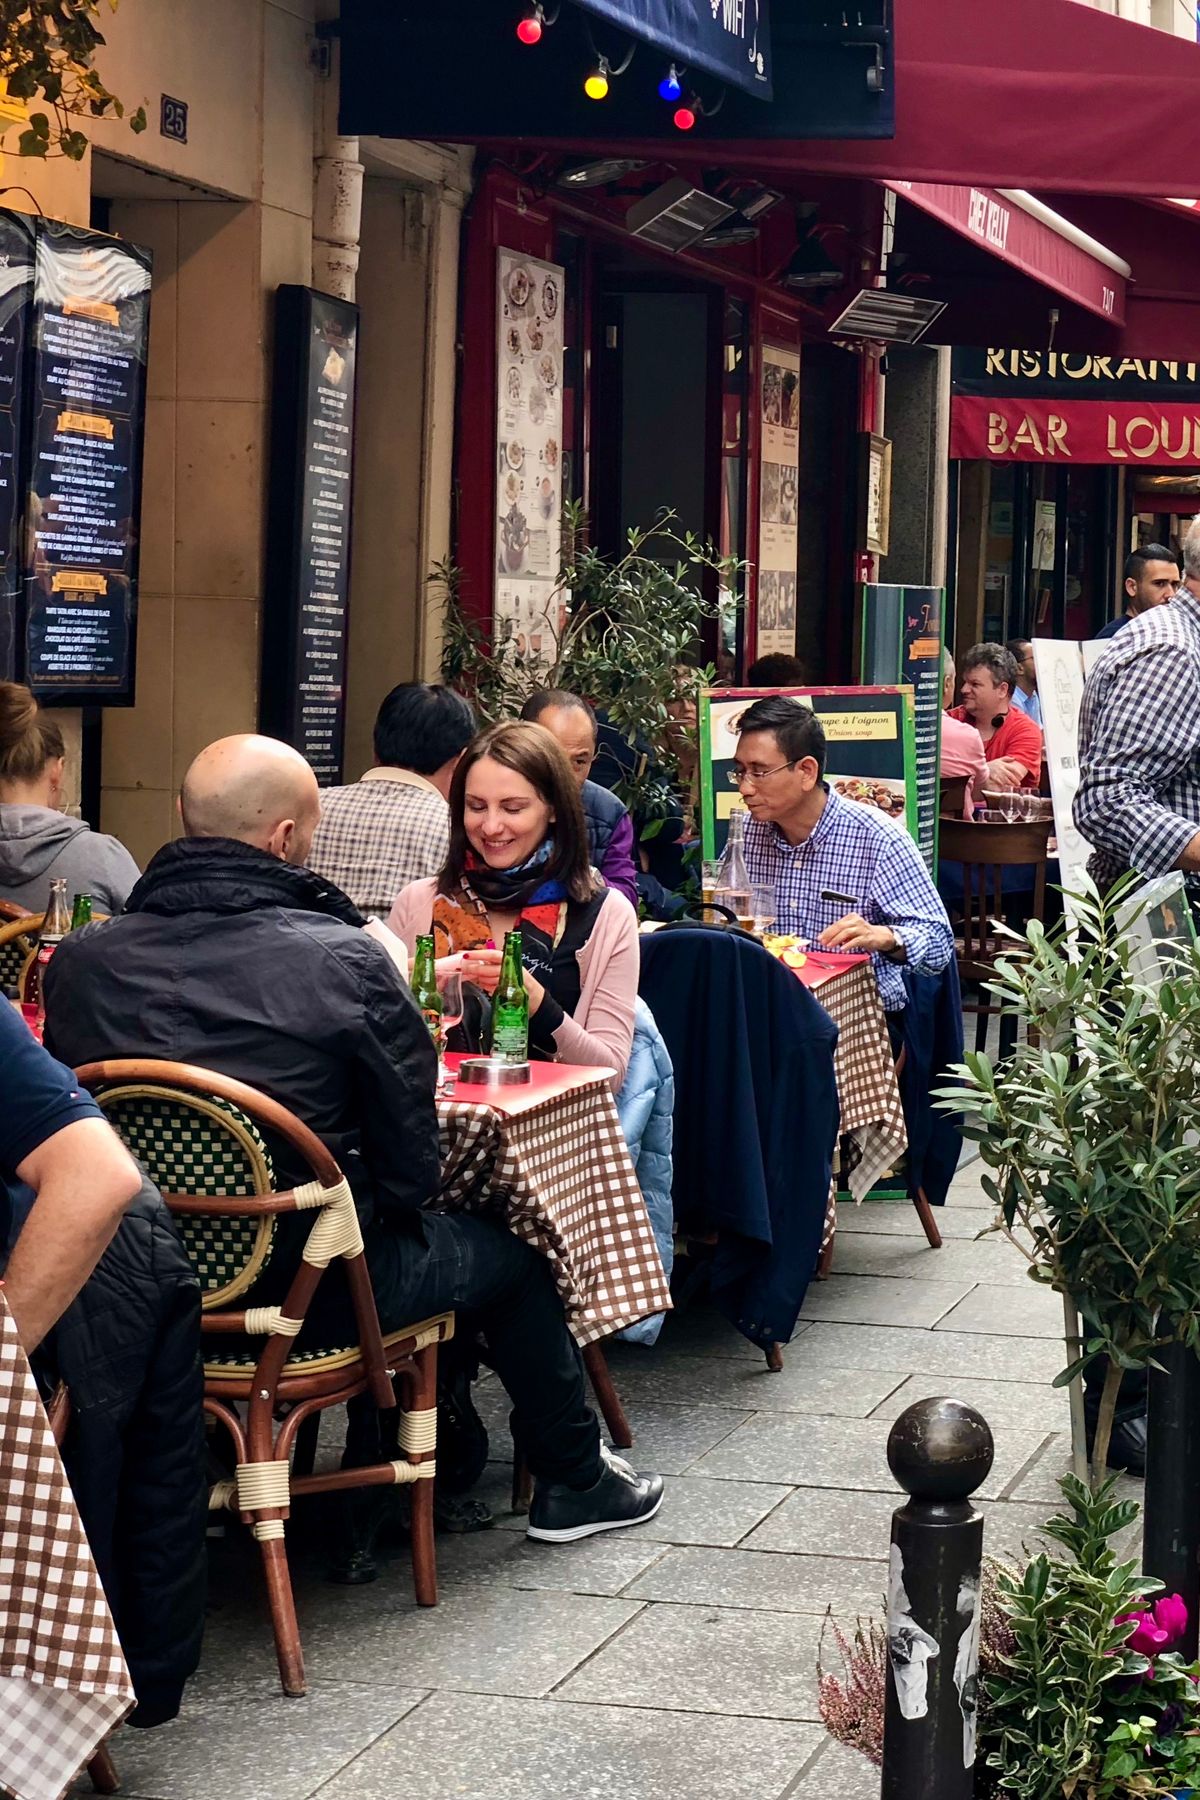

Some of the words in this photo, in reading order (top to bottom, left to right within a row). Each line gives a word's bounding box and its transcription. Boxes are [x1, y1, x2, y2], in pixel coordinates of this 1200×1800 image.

[166, 104, 184, 135] 25
[968, 187, 988, 238] CHEZ
[986, 199, 1010, 250] KELLY
[988, 412, 1072, 457] BAR
[852, 716, 889, 726] l'oignon
